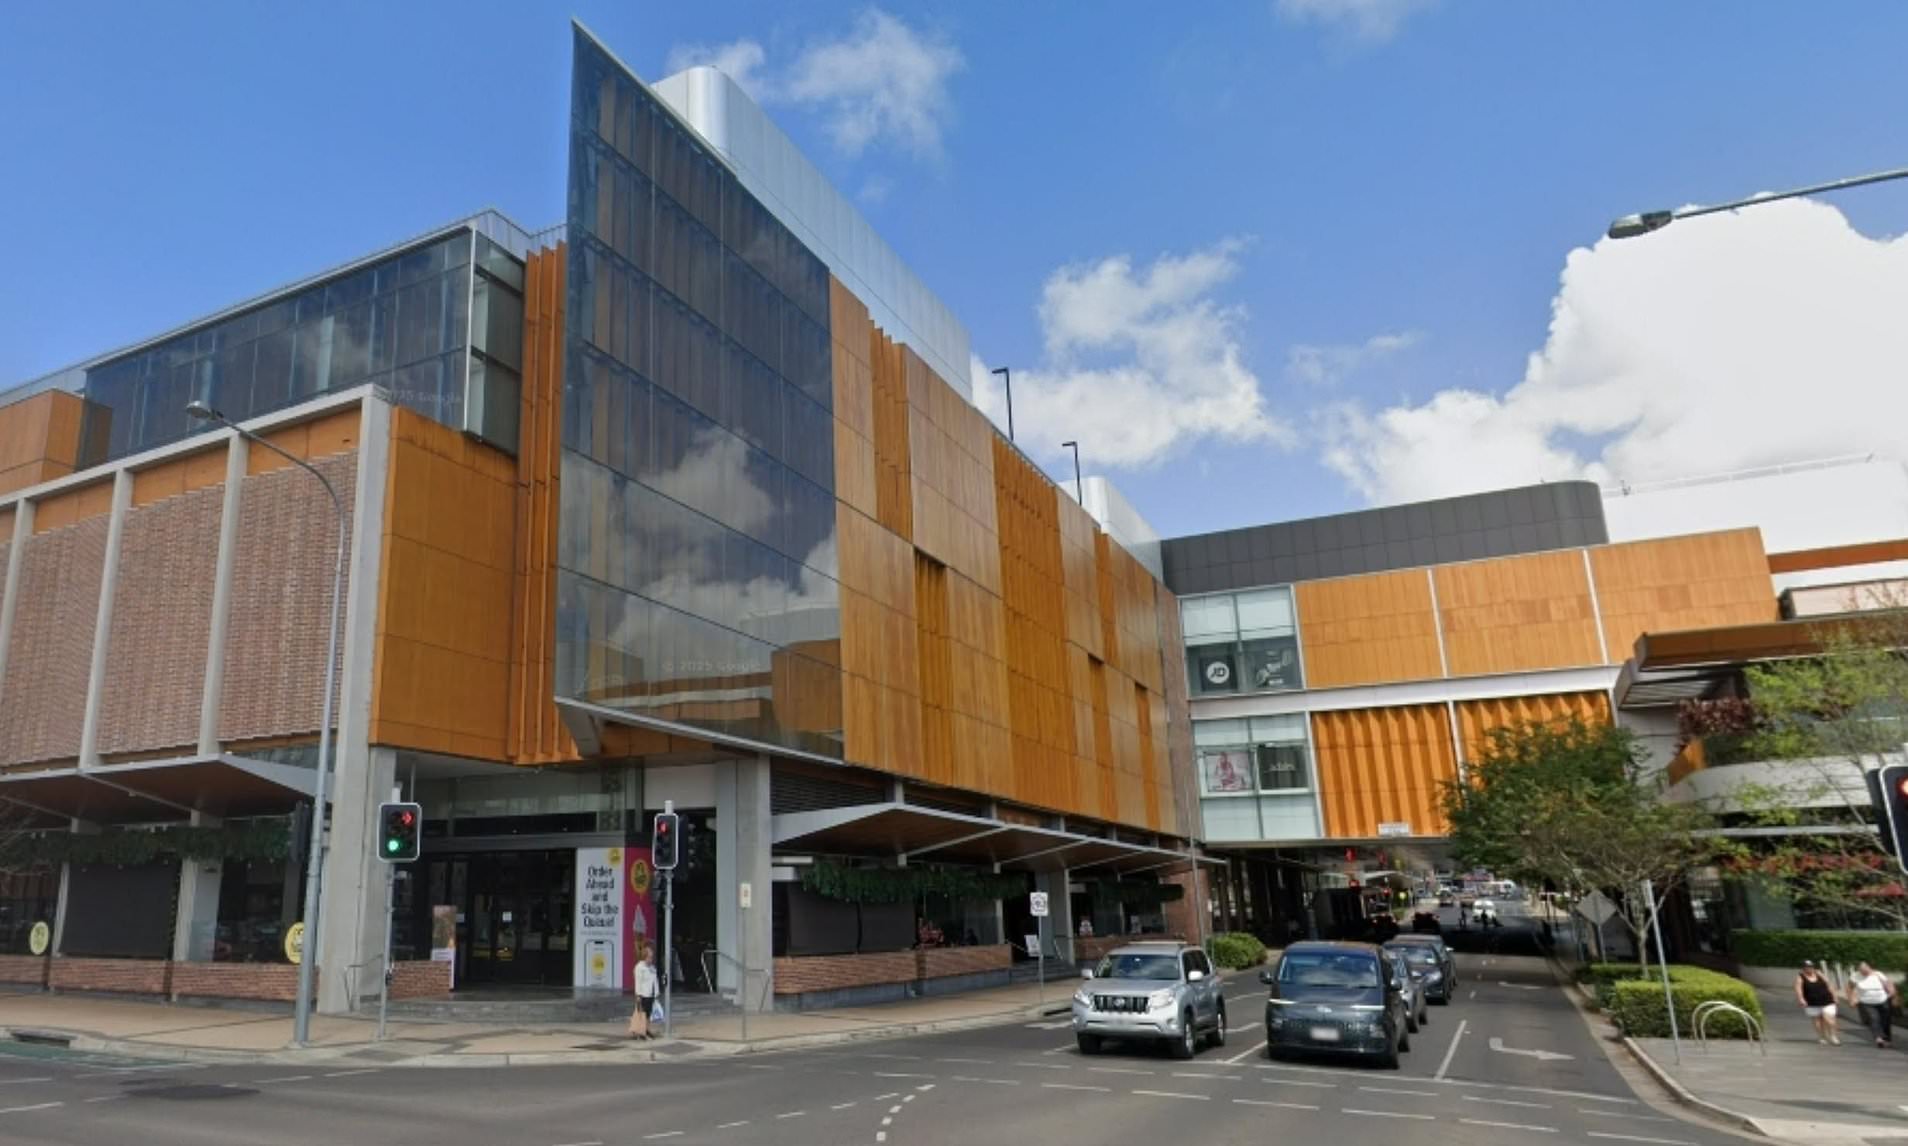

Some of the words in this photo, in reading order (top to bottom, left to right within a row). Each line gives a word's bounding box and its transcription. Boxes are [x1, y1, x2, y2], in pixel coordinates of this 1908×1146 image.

[588, 865, 612, 878] Order
[585, 878, 615, 889] Ahead
[592, 890, 608, 902] and
[581, 902, 602, 915] Skip
[603, 903, 618, 914] the
